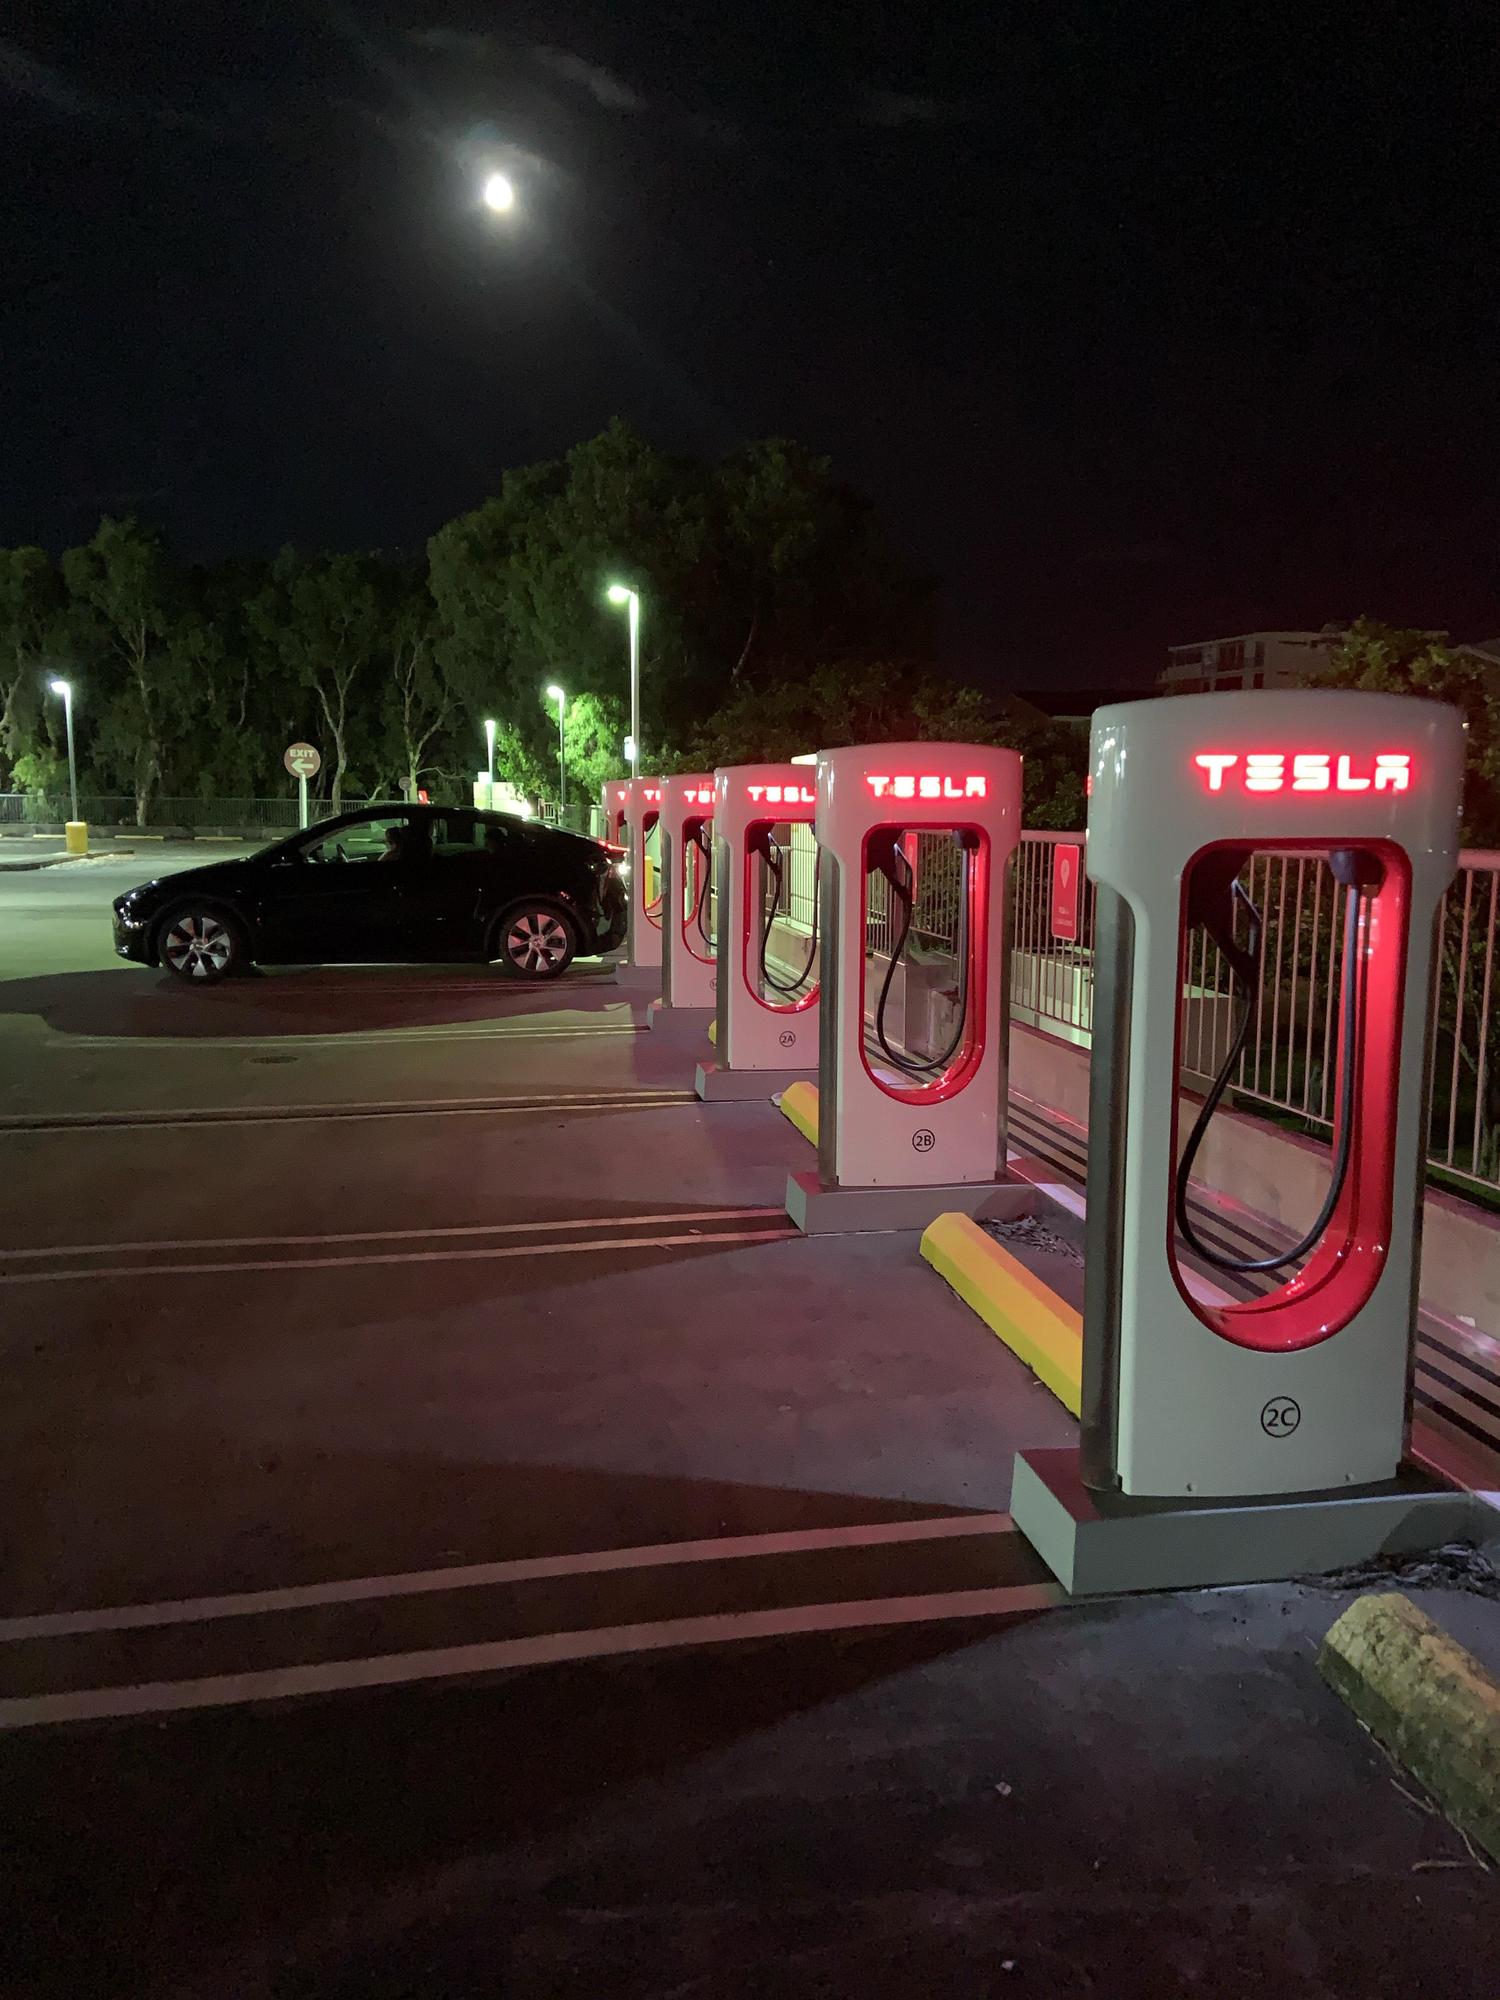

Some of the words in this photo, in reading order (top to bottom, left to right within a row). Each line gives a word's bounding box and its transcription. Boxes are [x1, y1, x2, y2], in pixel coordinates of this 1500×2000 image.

[290, 749, 315, 758] EXIT
[1195, 755, 1410, 790] TESLA
[747, 786, 815, 802] TESL
[867, 776, 986, 798] TESLA
[916, 1135, 932, 1146] 2B
[1267, 1407, 1295, 1427] 2C
